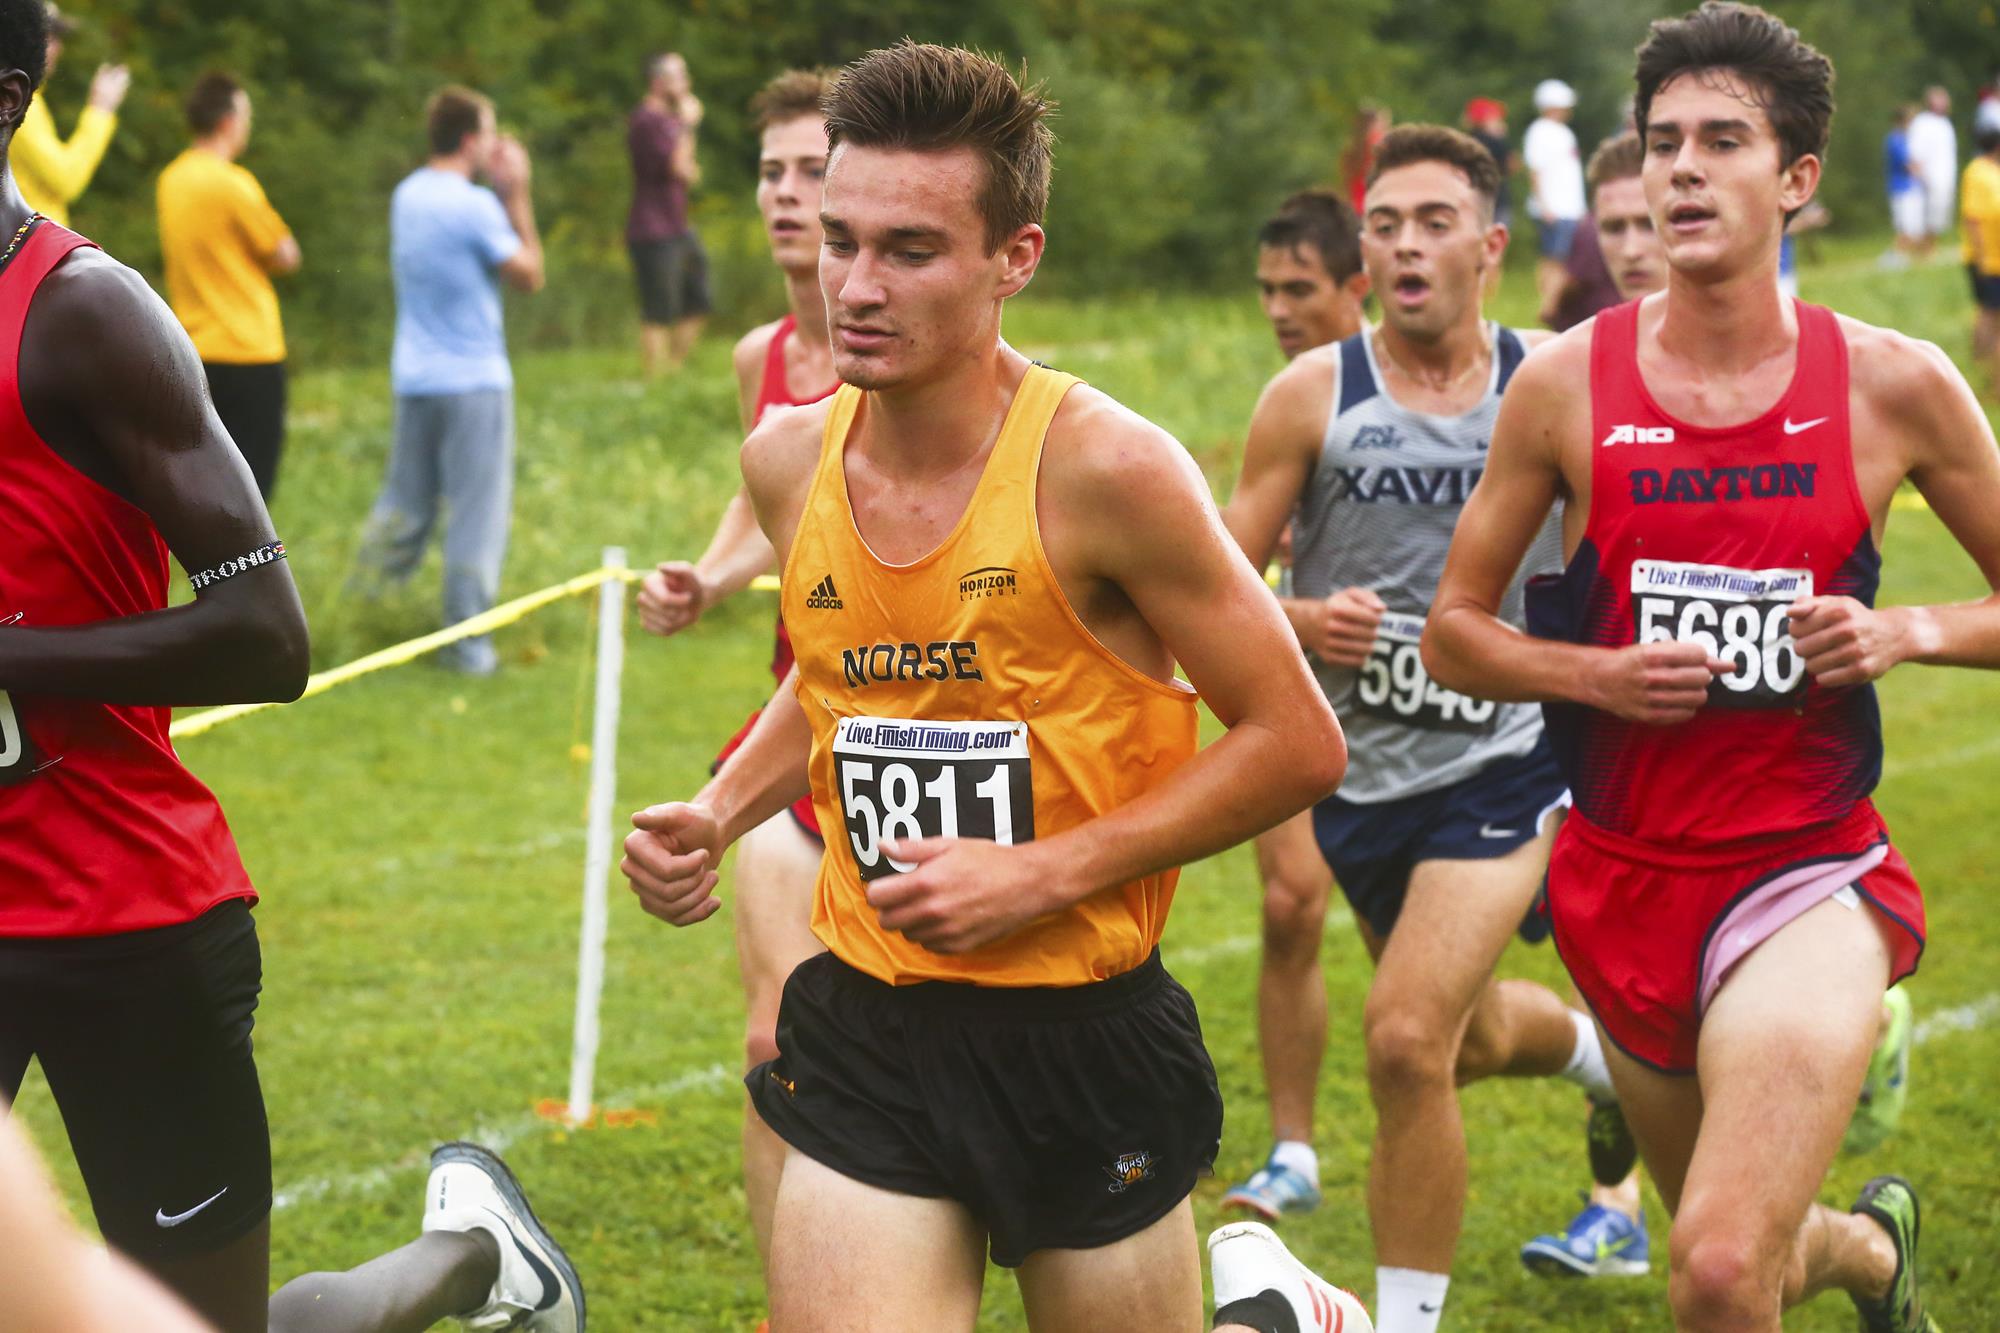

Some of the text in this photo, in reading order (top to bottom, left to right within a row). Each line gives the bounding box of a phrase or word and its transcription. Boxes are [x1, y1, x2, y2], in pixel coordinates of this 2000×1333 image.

[1630, 461, 1818, 505] DAYTON
[190, 545, 274, 590] TRONG
[960, 575, 1016, 594] HORIZON
[806, 596, 844, 610] adidas
[842, 640, 985, 689] NORSE
[845, 722, 1012, 753] Live.FinishTiming.com
[841, 760, 1015, 874] 5811
